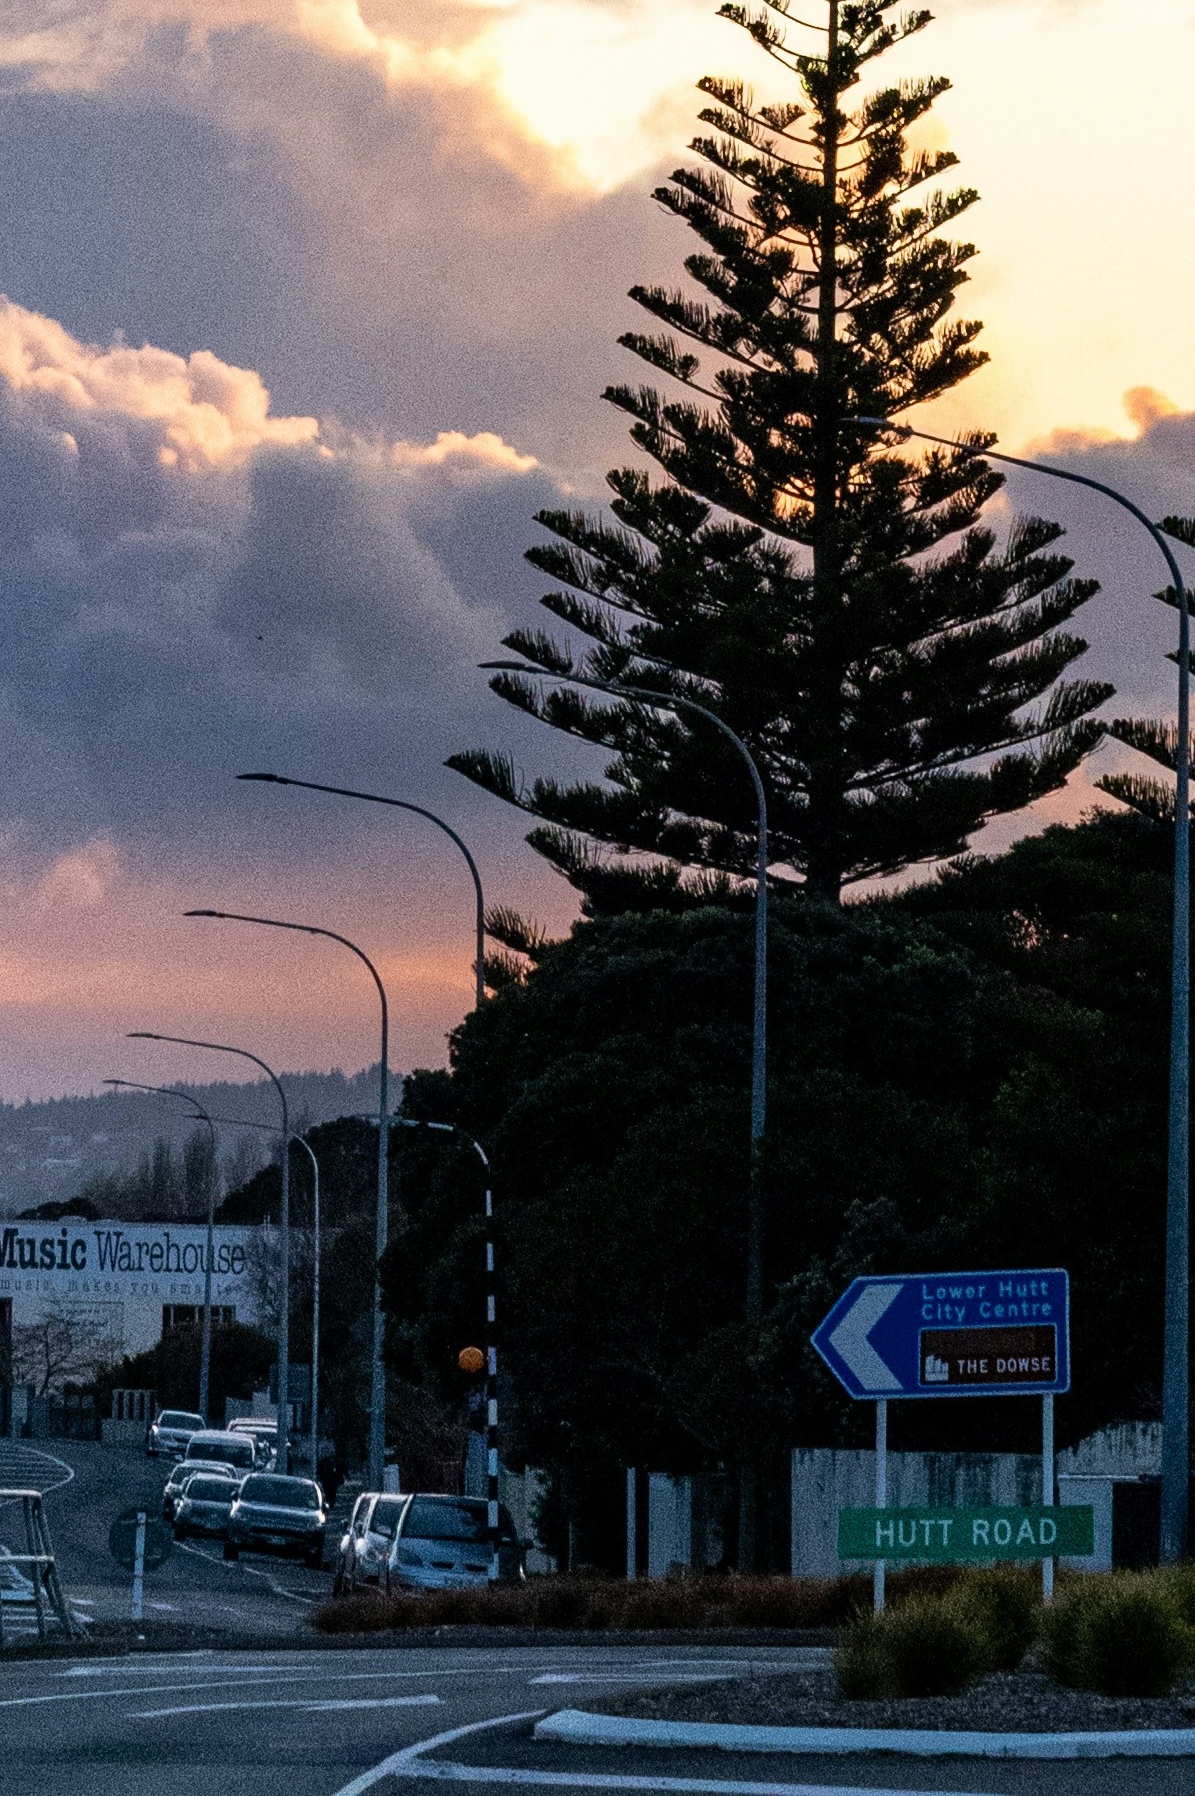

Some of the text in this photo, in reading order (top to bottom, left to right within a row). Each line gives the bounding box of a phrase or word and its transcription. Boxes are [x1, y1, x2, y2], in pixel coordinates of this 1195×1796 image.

[93, 1230, 246, 1275] Warehouse
[921, 1280, 1049, 1301] Lower Hutt
[921, 1300, 1052, 1323] City Centre
[957, 1356, 1052, 1375] THE DOWSE
[875, 1517, 1058, 1548] HUTT ROAD
